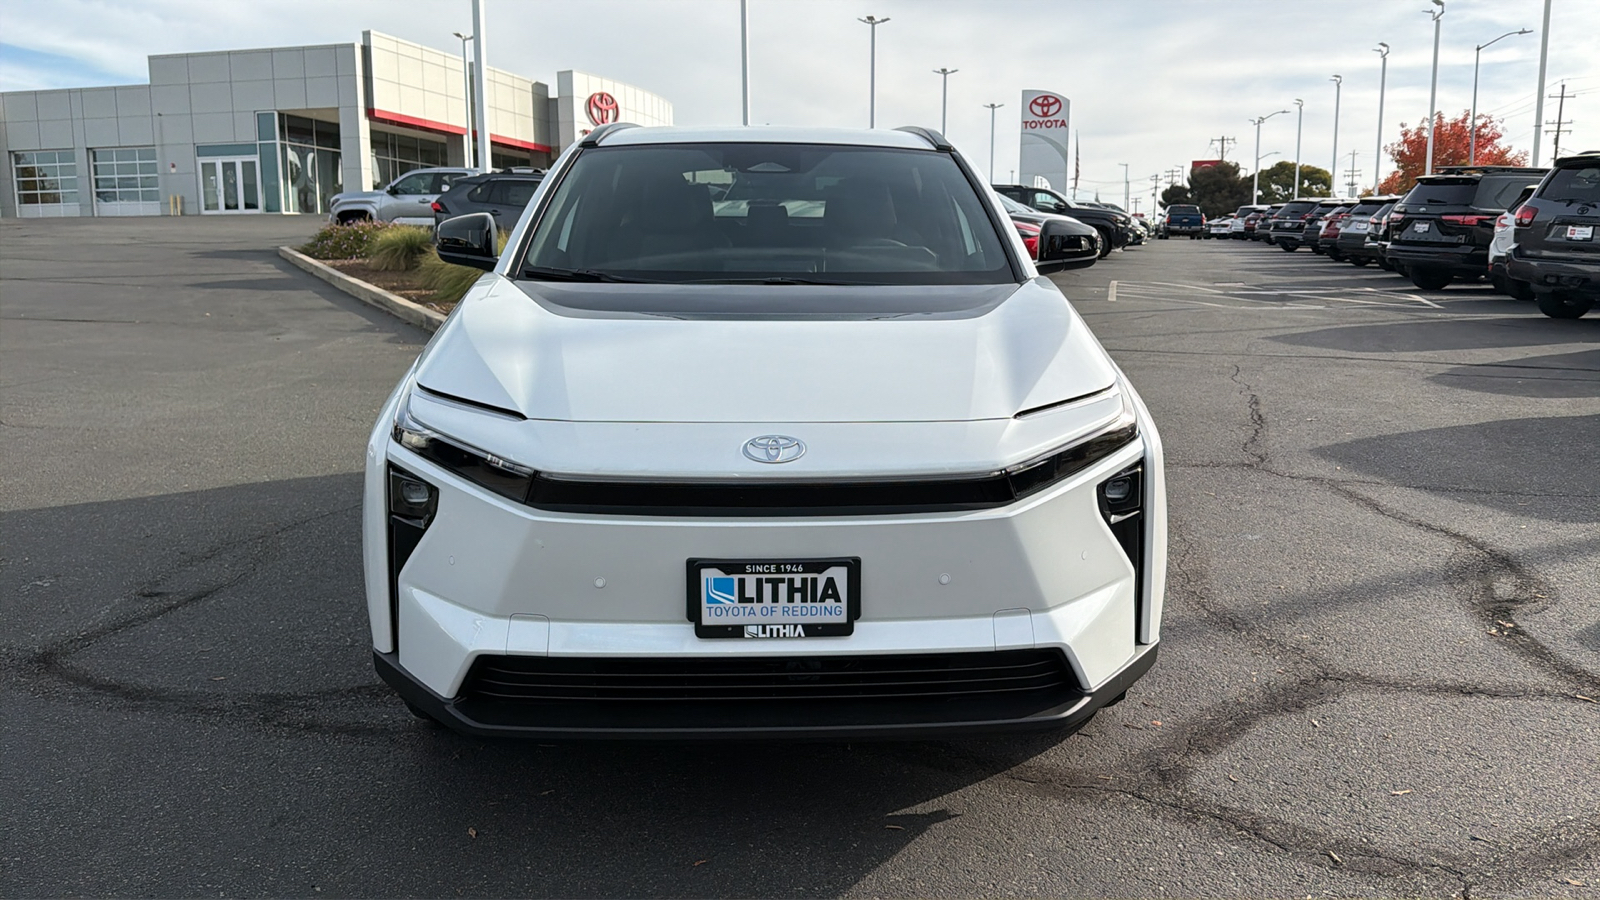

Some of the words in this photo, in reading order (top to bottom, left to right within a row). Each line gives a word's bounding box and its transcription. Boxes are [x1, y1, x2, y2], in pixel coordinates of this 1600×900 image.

[1022, 120, 1067, 129] TOYOTA
[745, 564, 777, 573] SINCE
[780, 564, 804, 573] 1946
[738, 577, 842, 604] LITHIA
[706, 606, 756, 617] TOYOTA
[760, 606, 778, 617] OF
[782, 606, 842, 616] REDDING
[758, 624, 805, 638] LITHIA
